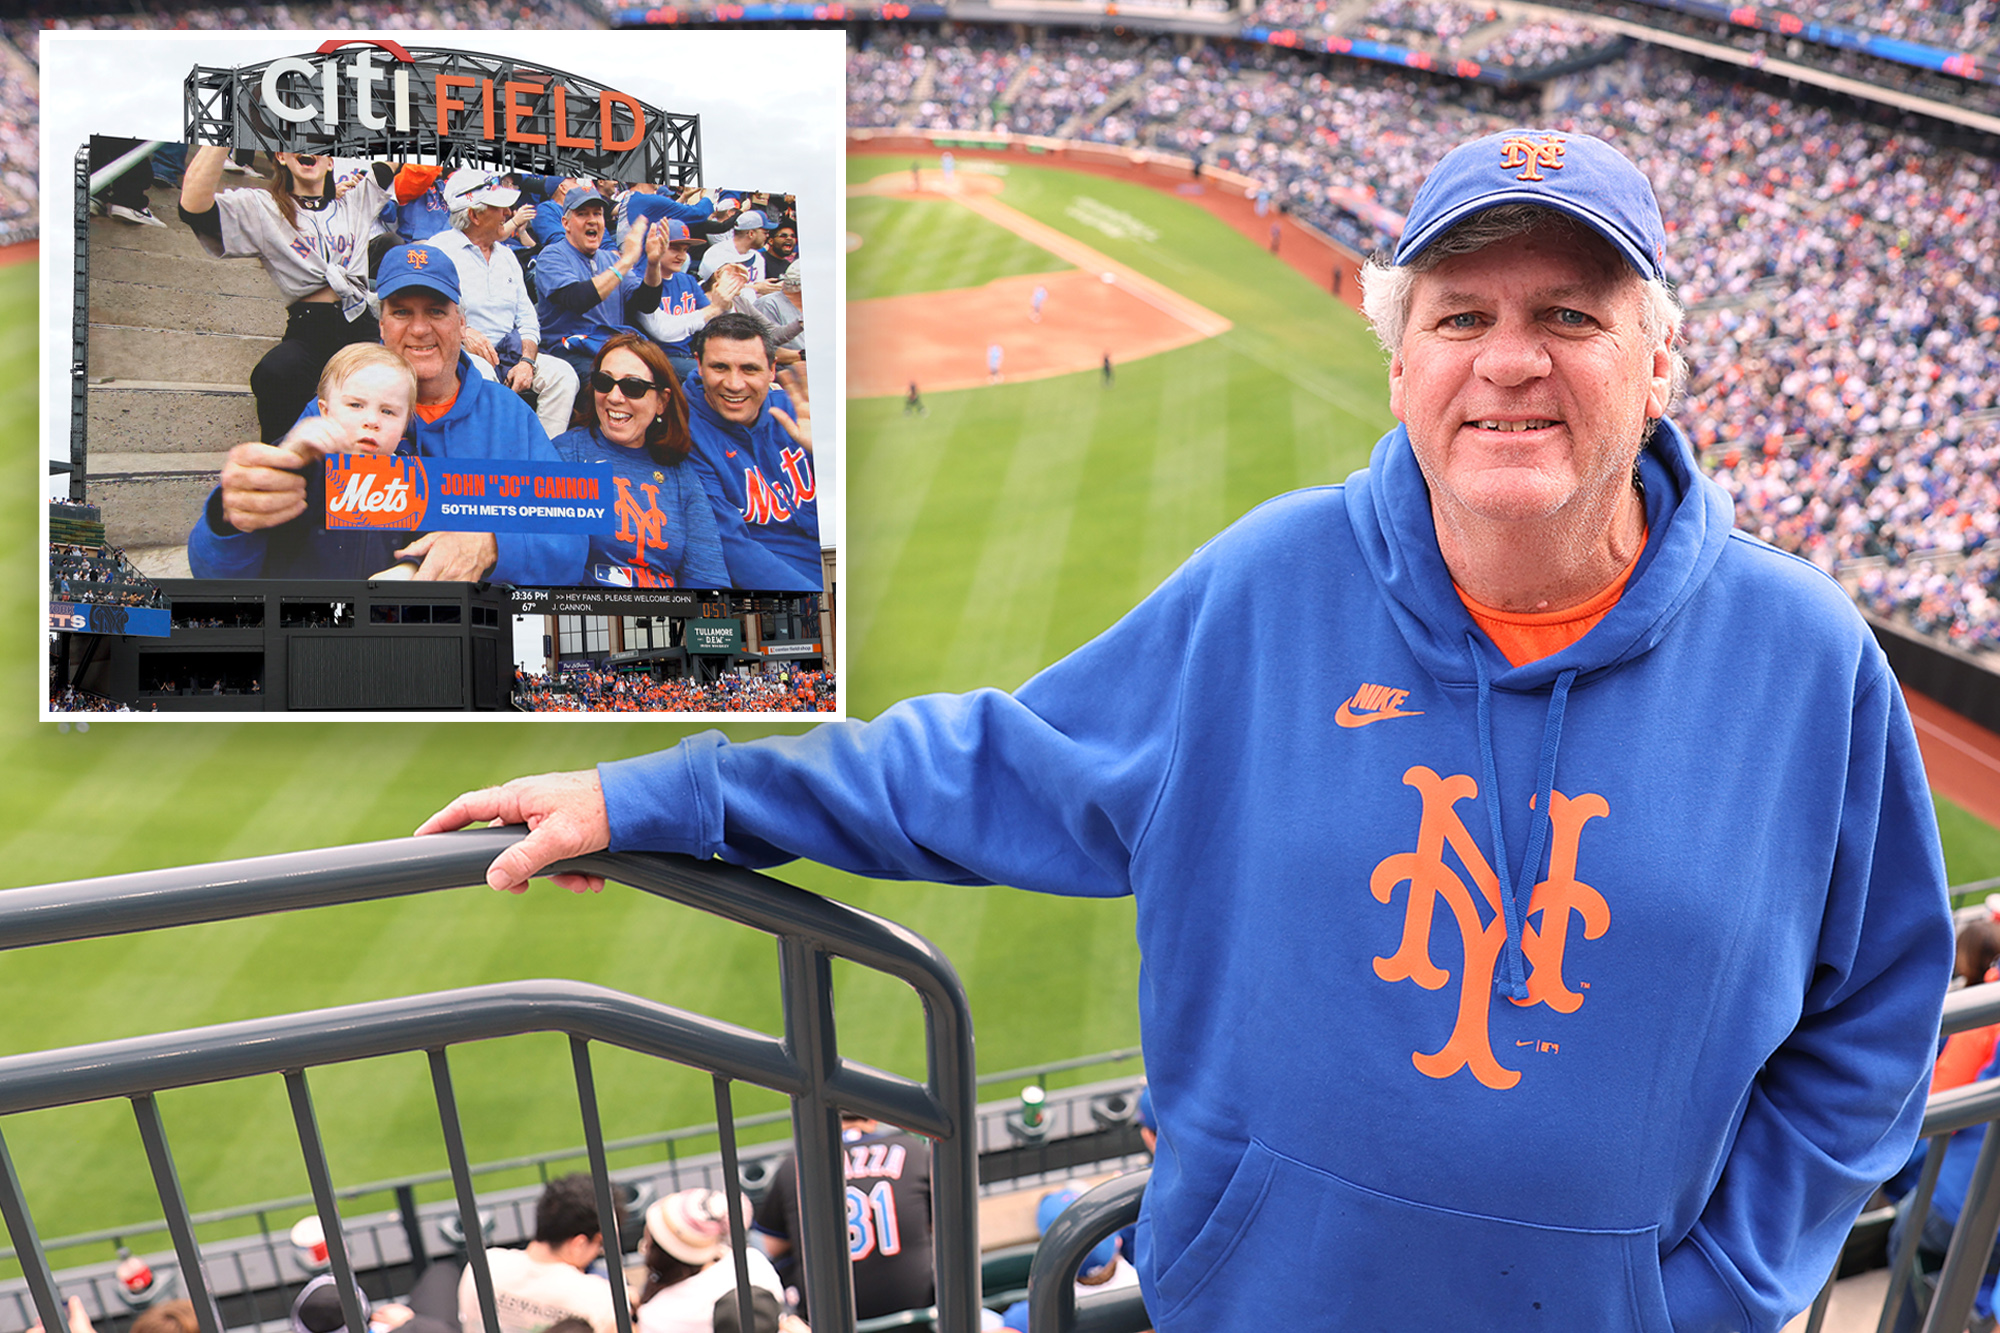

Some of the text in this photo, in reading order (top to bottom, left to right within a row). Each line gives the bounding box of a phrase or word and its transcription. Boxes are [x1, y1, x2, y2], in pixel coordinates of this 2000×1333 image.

[261, 48, 646, 152] citi FIELD
[1500, 134, 1566, 181] NY
[407, 249, 428, 270] NY
[329, 473, 410, 513] Mets
[441, 473, 599, 500] JOHN "JC" CANNON
[441, 503, 605, 519] 50TH METS OPENING DAY
[534, 591, 549, 601] PM
[565, 593, 582, 601] HEY
[604, 594, 633, 602] PLEASE
[634, 595, 670, 603] WELCOME
[671, 595, 692, 603] JOHN
[703, 603, 727, 618] 0:57
[694, 627, 734, 637] TULLAMORE
[1350, 682, 1411, 712] NIKE
